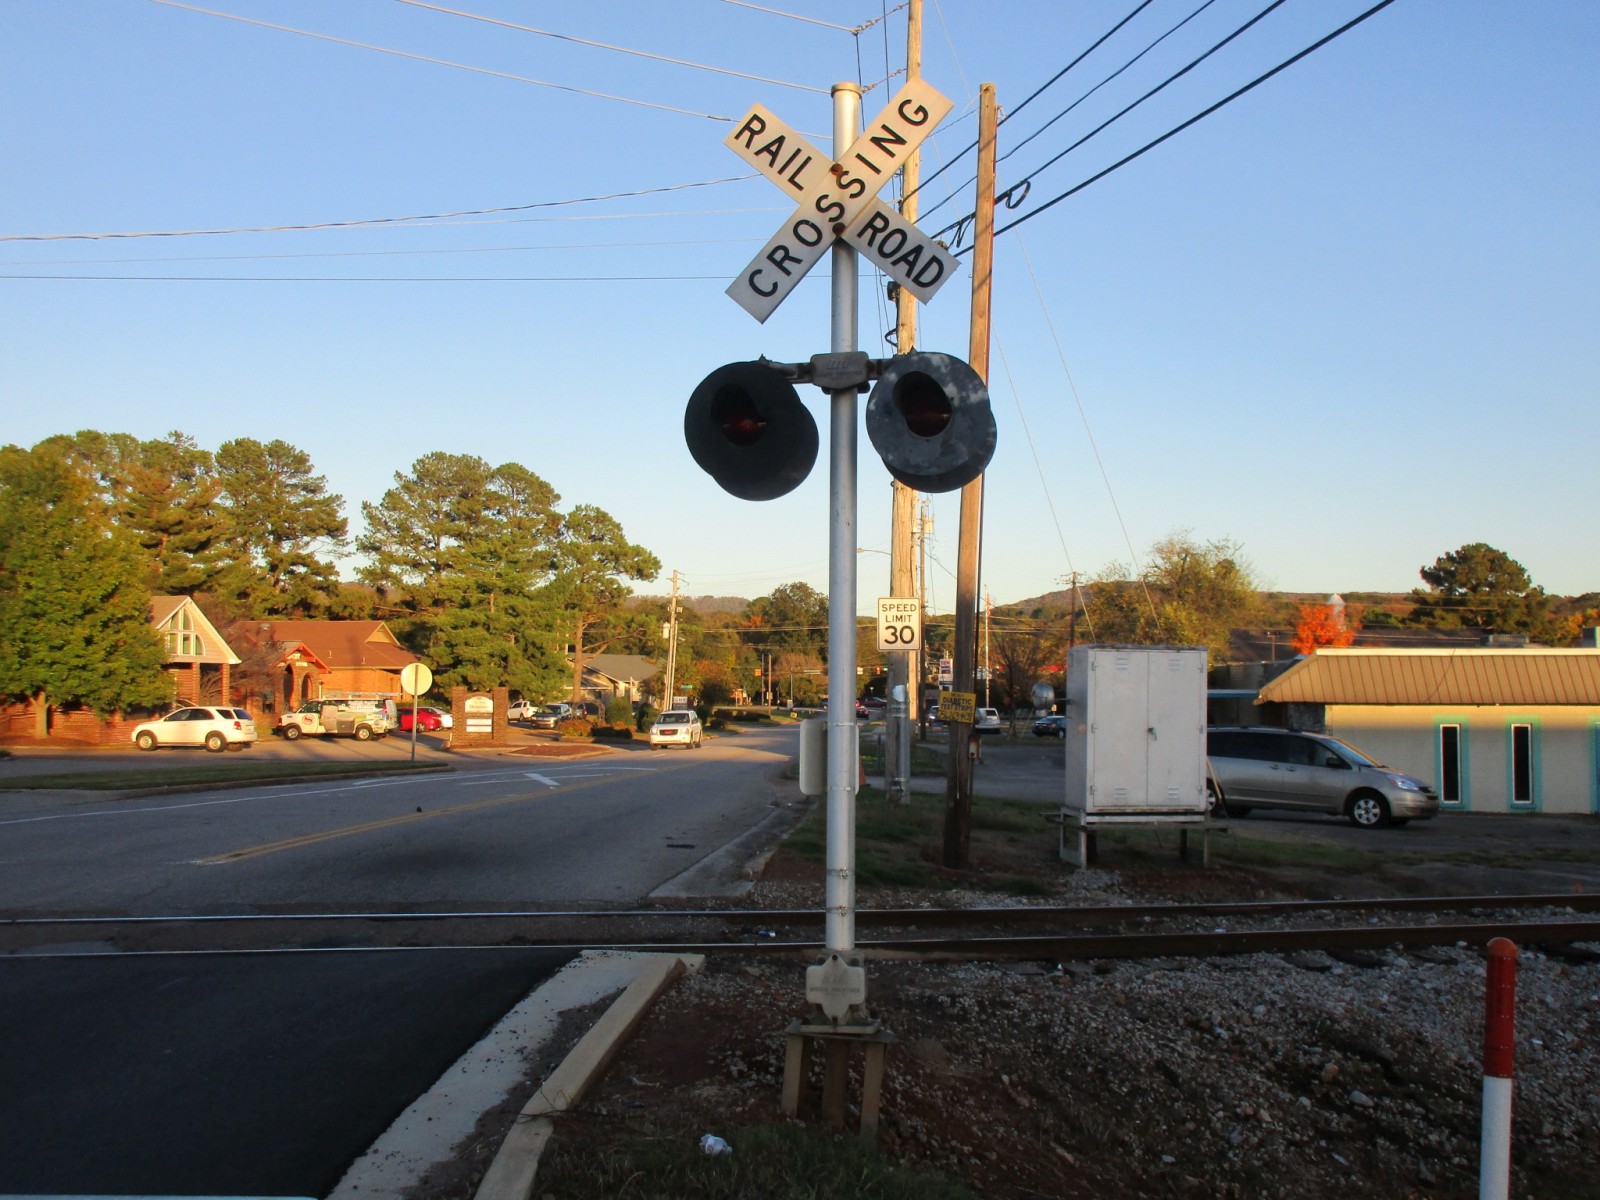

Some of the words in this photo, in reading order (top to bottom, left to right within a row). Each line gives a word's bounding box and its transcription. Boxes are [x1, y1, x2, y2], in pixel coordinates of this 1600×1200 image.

[734, 113, 812, 191] RAIL
[856, 211, 945, 289] ROAD
[748, 99, 929, 298] CROSSING
[881, 603, 917, 612] SPEED
[885, 614, 912, 622] LIMIT
[884, 625, 915, 645] 30
